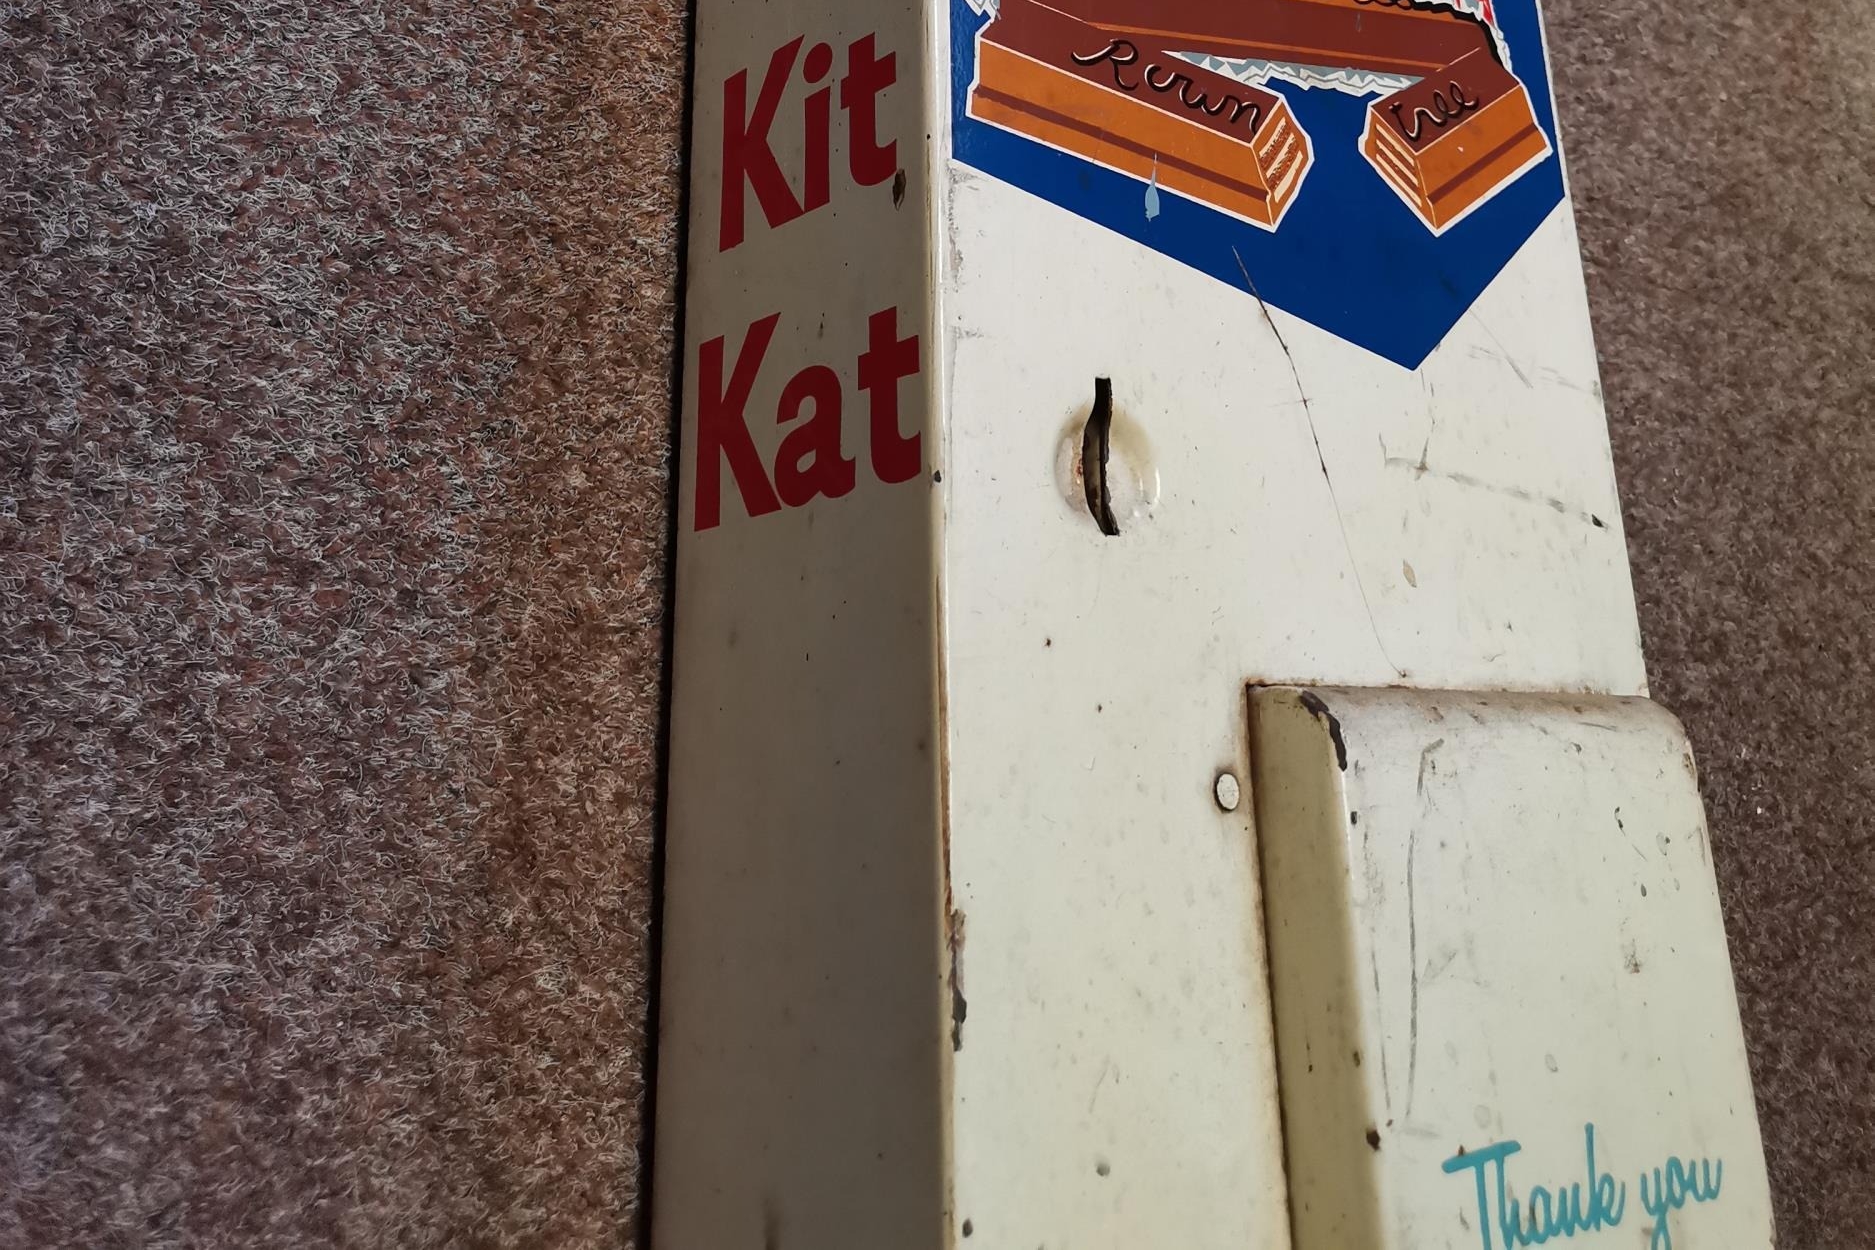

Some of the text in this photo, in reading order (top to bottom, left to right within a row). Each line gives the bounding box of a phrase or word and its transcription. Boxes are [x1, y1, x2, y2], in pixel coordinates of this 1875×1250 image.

[719, 30, 898, 254] Kit
[694, 305, 922, 533] Kat
[1441, 1122, 1723, 1250] Thank you
